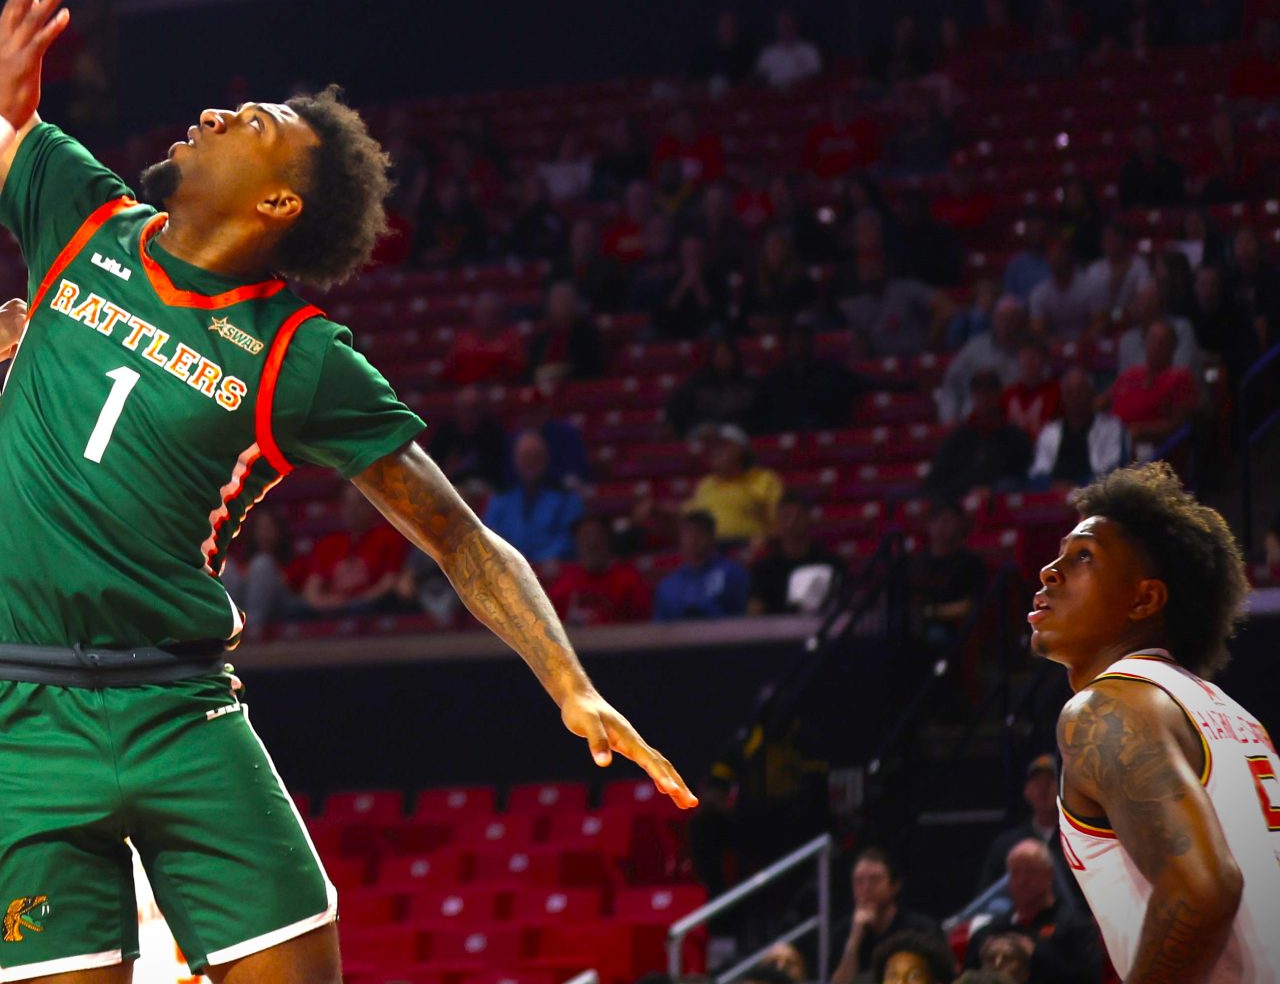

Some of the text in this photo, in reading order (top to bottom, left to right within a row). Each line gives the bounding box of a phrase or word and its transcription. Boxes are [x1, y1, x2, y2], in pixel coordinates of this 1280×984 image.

[50, 278, 248, 412] RATTLERS
[223, 326, 263, 354] SWAC
[83, 365, 141, 464] 1
